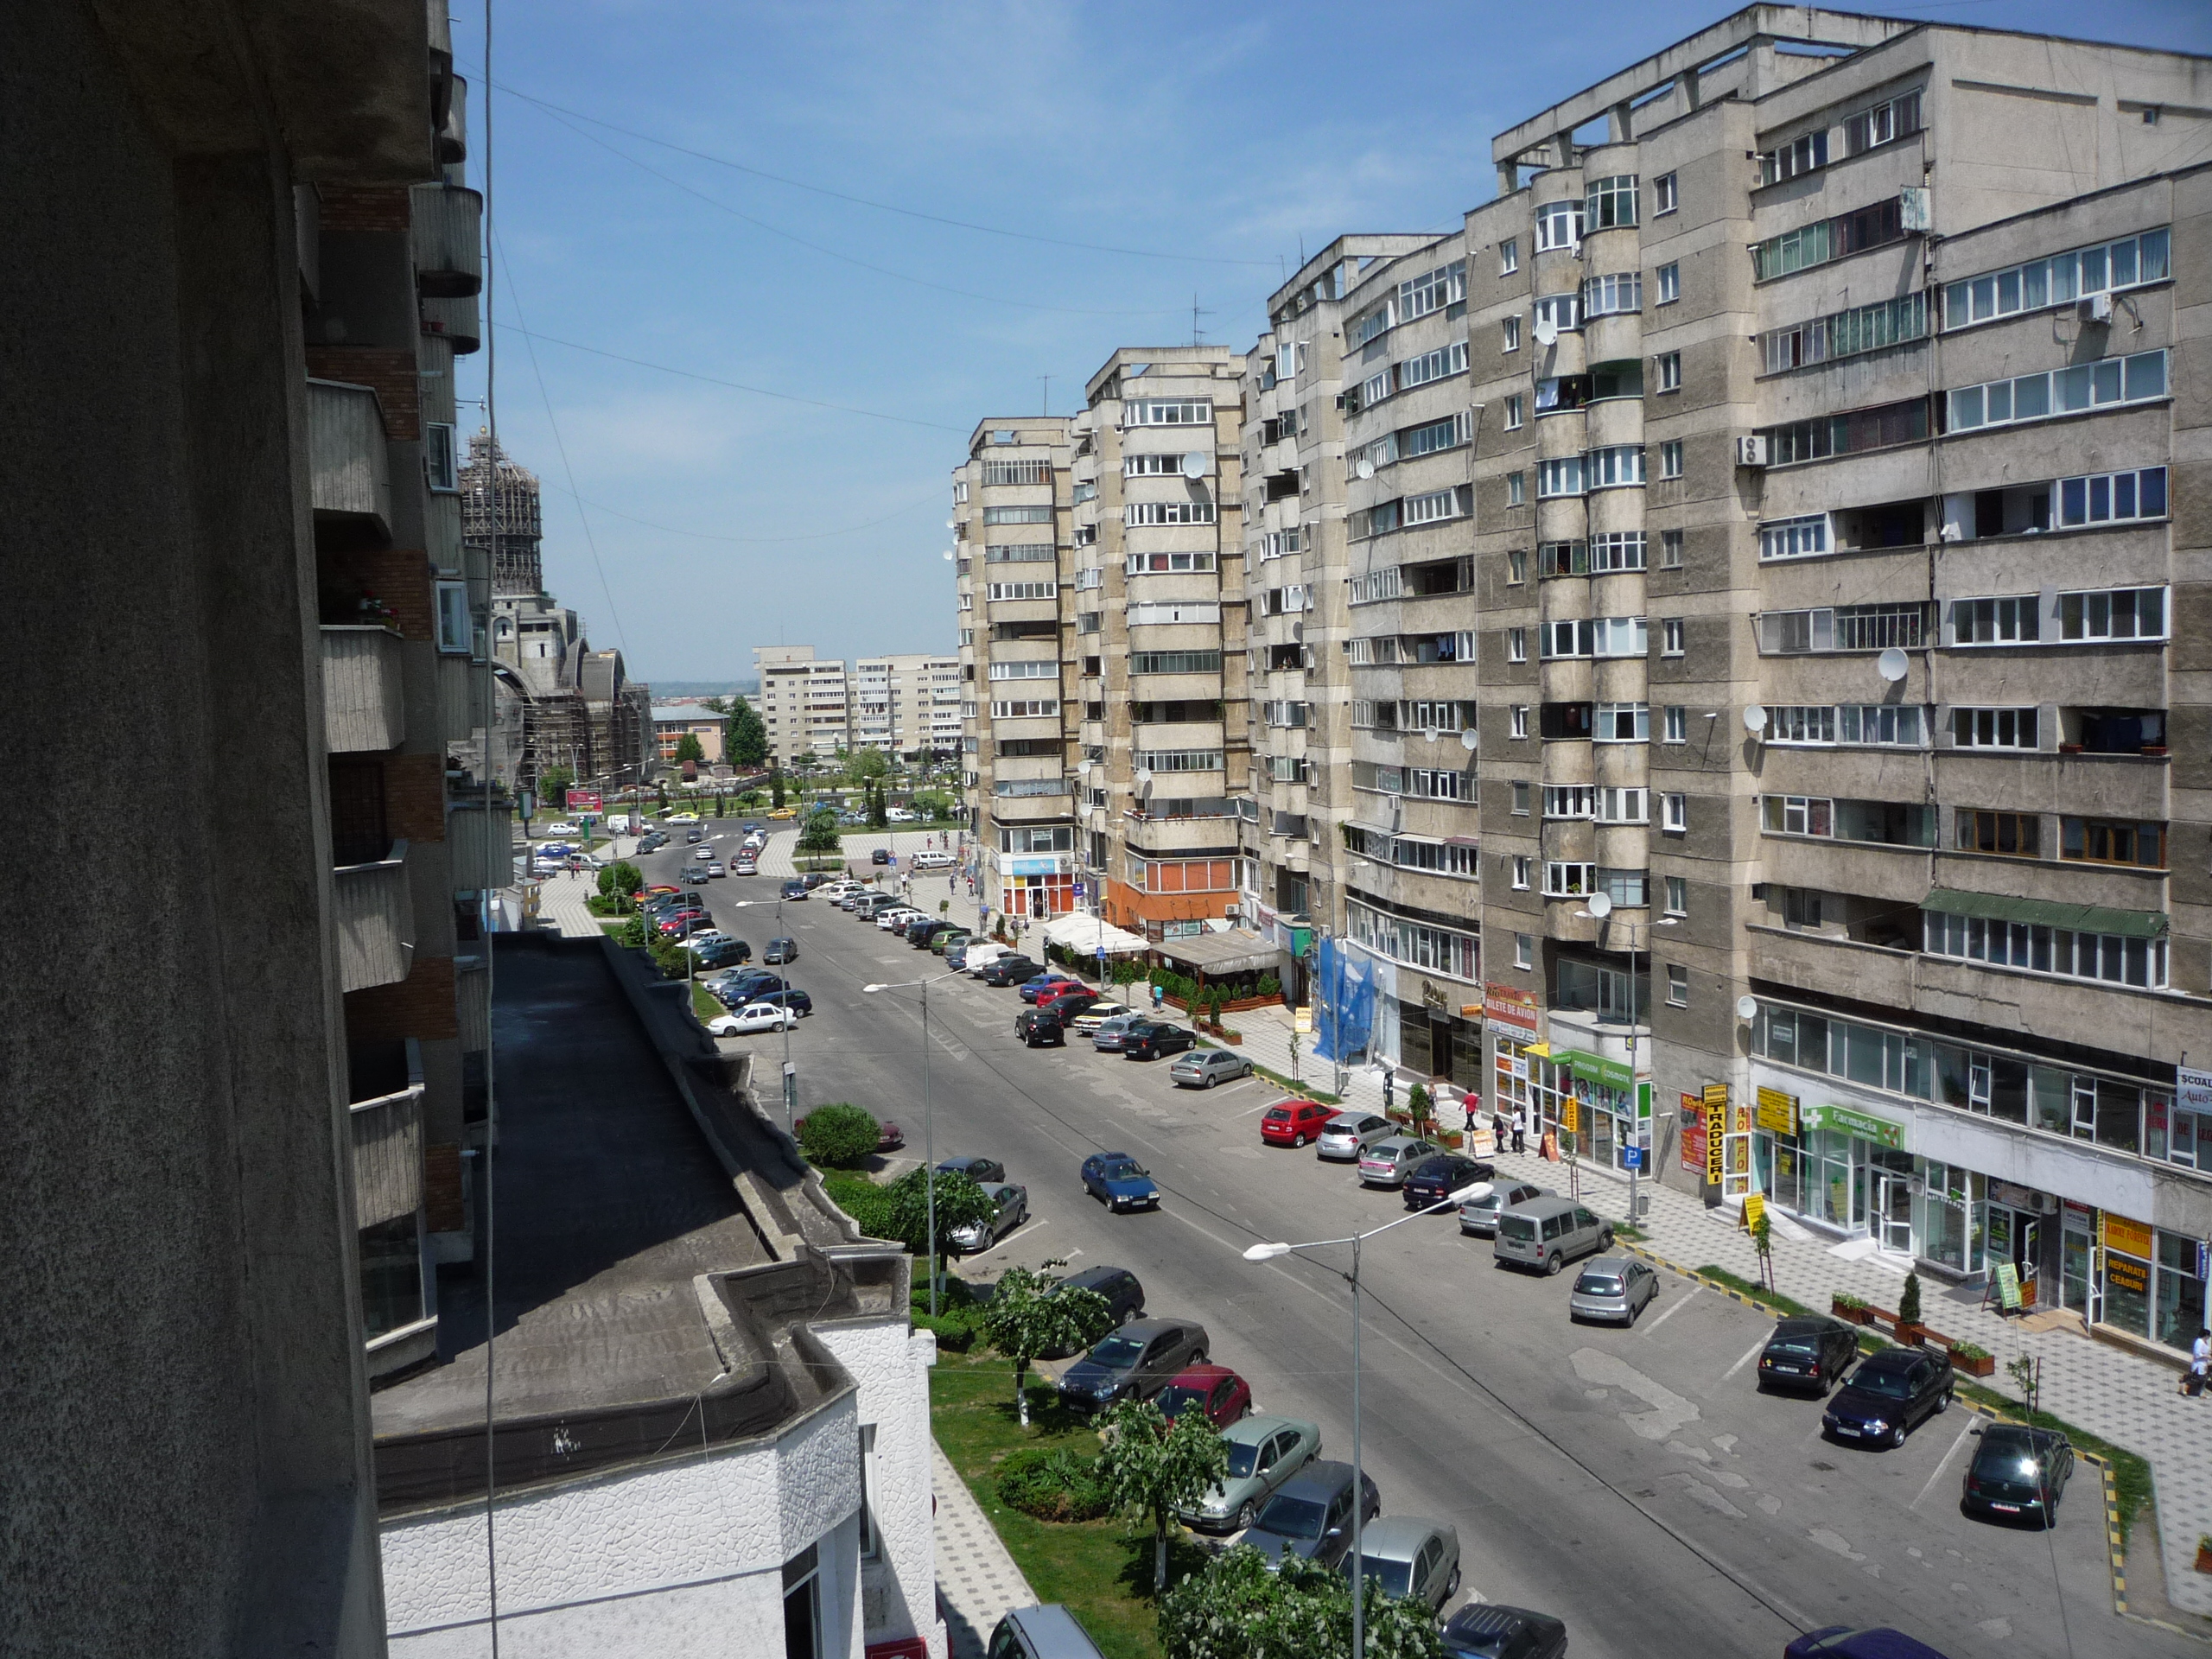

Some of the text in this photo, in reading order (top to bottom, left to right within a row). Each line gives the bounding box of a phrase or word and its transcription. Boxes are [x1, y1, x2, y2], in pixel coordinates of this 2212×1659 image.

[1487, 999, 1506, 1013] BILETE
[1508, 1004, 1516, 1015] DE
[1516, 1007, 1535, 1020] AVION
[1574, 1060, 1630, 1084] PROGSM COSMOTE
[1833, 1109, 1878, 1134] Farmacia
[1709, 1104, 1724, 1183] TRADUCERI
[1628, 1150, 1637, 1162] P
[2110, 1273, 2144, 1292] CEASURI
